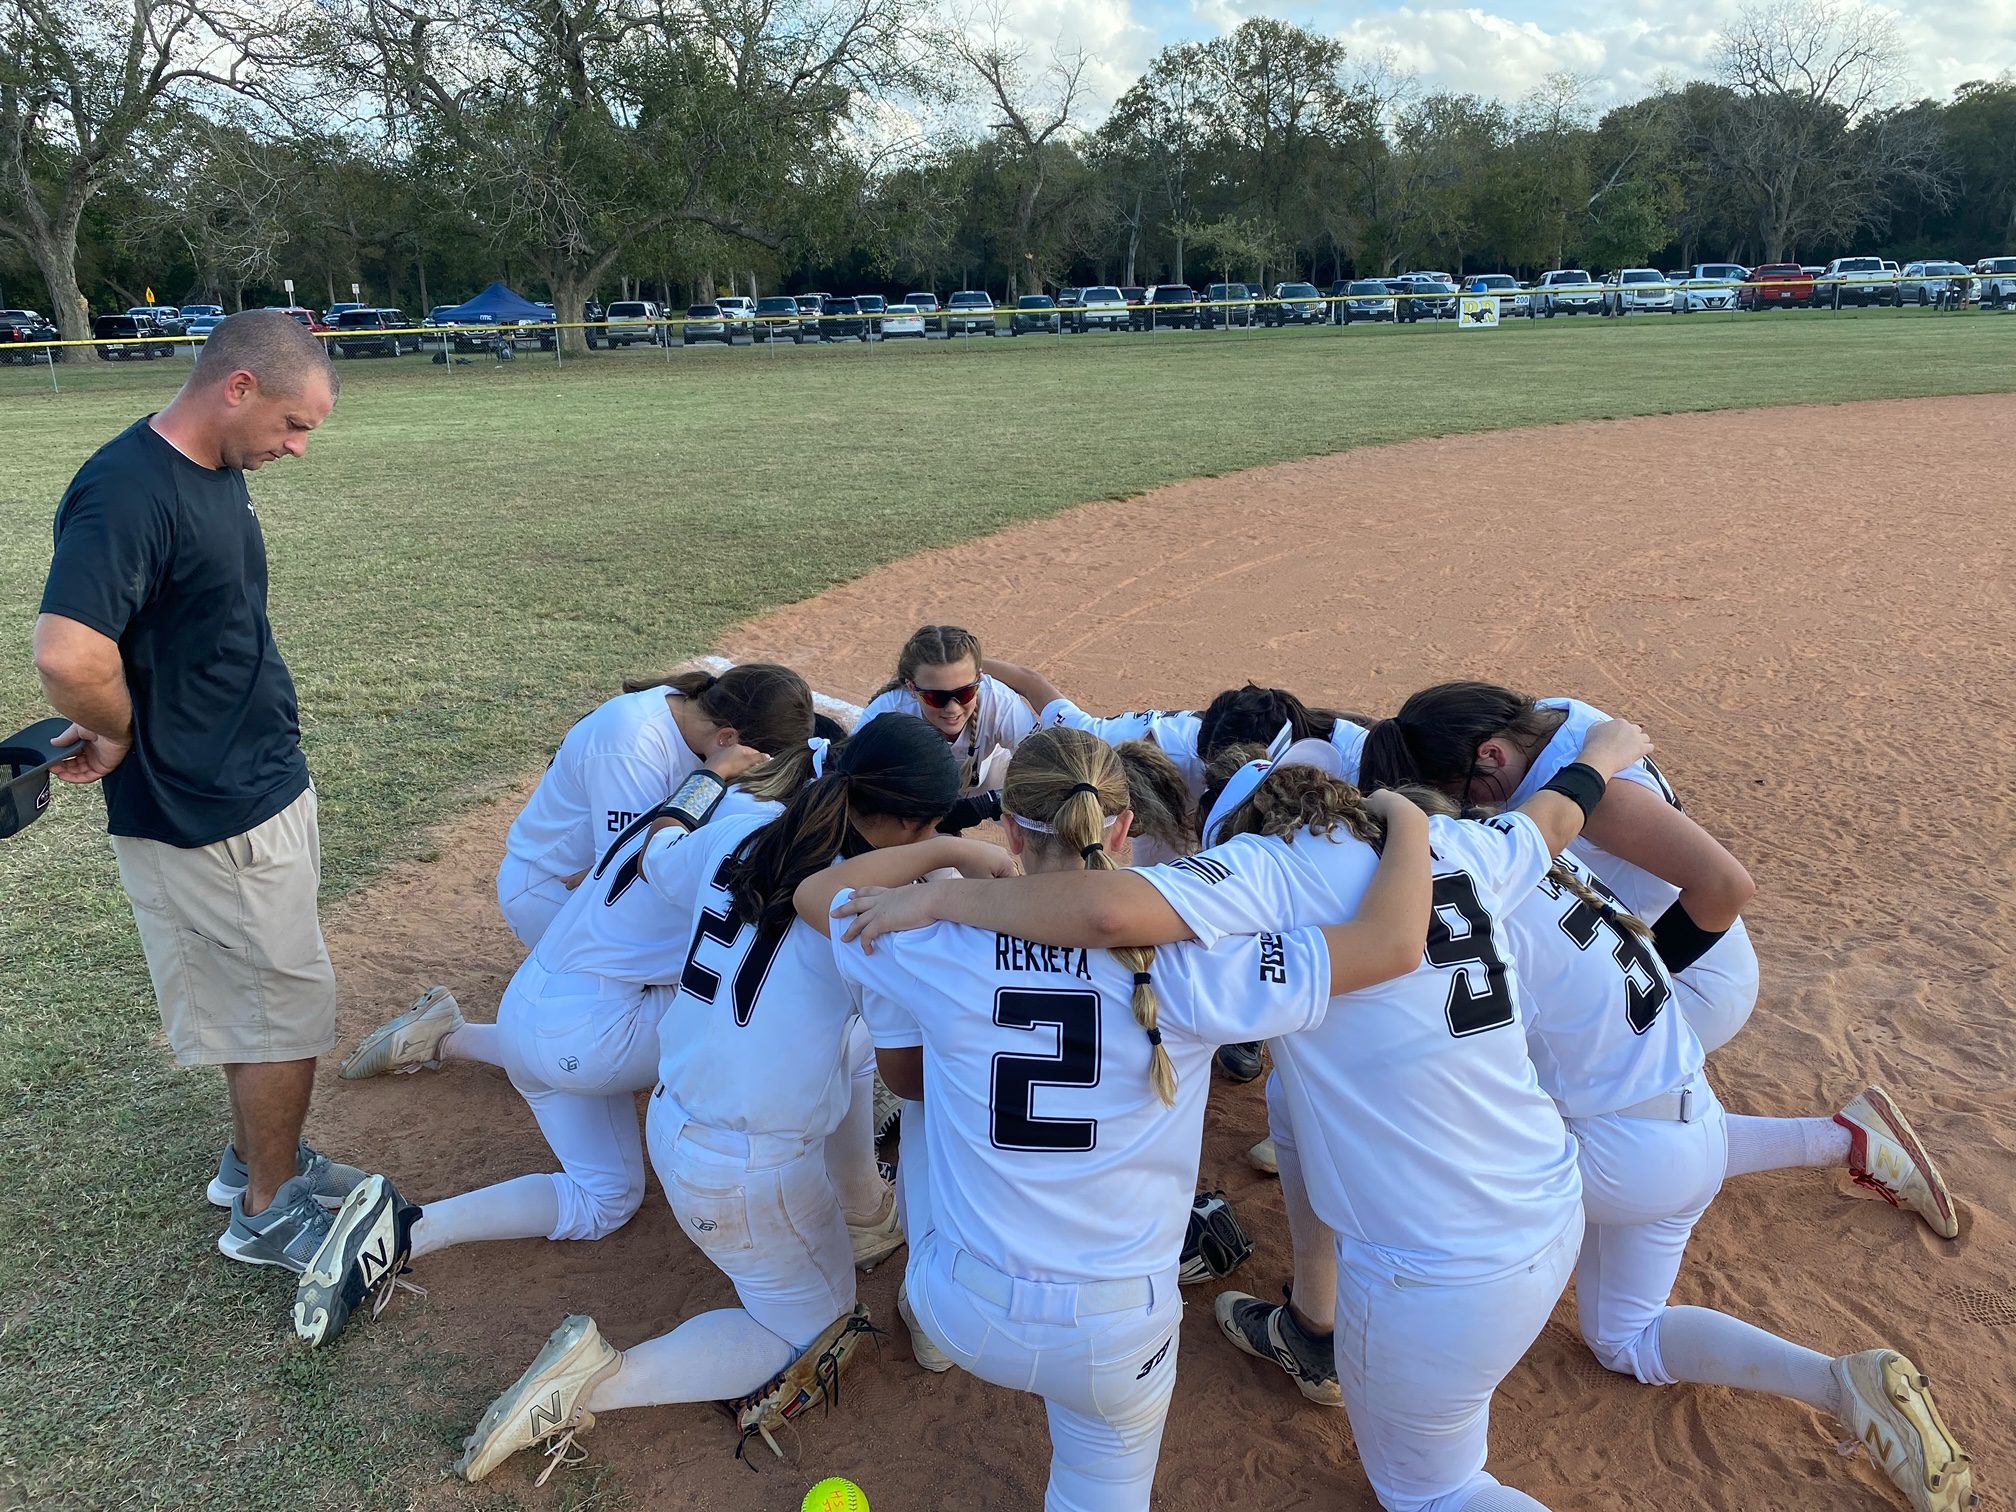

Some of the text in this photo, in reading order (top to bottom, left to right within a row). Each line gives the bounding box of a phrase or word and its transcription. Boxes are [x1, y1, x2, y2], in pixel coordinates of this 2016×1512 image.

[1515, 296, 1529, 304] 200
[995, 931, 1092, 981] REKIETA
[1424, 869, 1515, 1038] 9
[989, 986, 1102, 1152] 2
[530, 1389, 563, 1438] N
